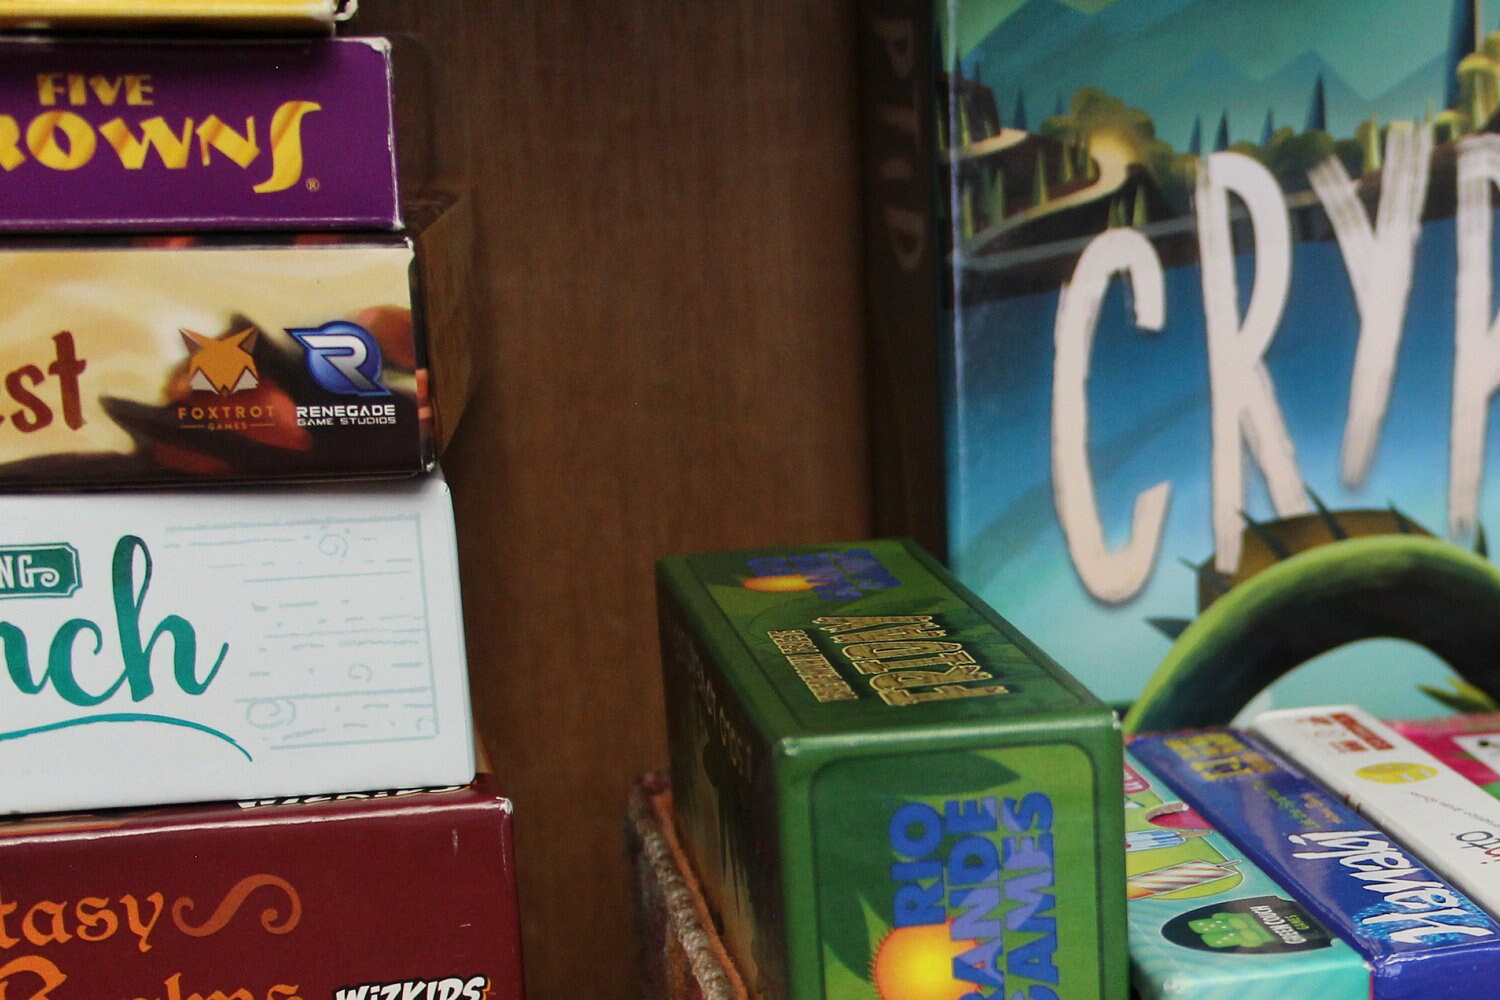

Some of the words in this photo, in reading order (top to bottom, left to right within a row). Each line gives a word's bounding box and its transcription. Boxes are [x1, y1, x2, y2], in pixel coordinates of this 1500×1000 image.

[37, 72, 154, 106] FIVE
[0, 331, 87, 434] st
[178, 405, 276, 420] FOXTROT
[207, 422, 248, 431] GAMES
[295, 404, 397, 417] RENEGADE
[296, 417, 335, 427] GAME
[339, 416, 397, 427] STUDIOS
[812, 615, 1008, 706] FRIDAY
[889, 802, 945, 928] RIO
[1286, 830, 1496, 945] Hanabi
